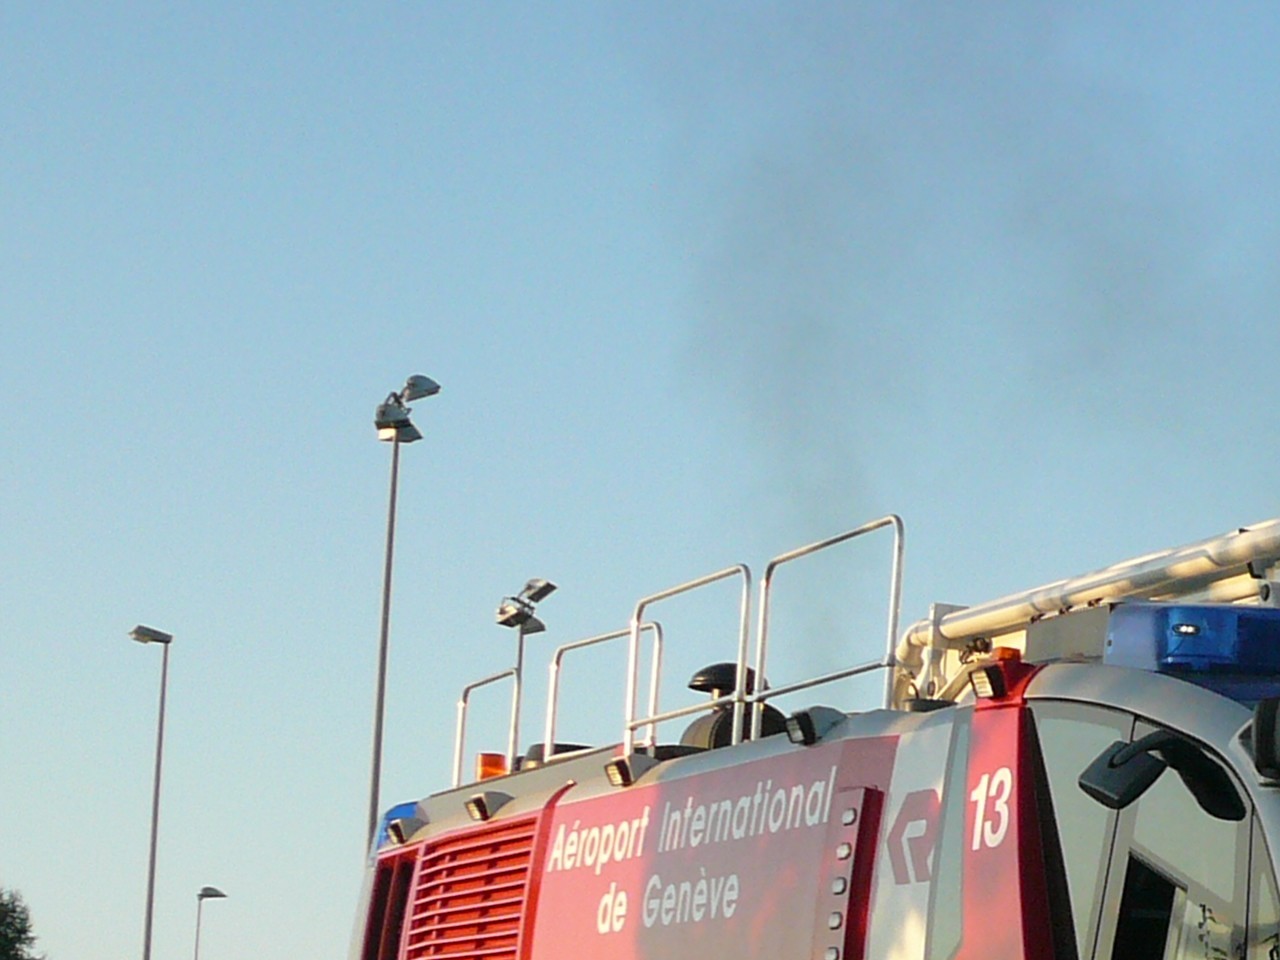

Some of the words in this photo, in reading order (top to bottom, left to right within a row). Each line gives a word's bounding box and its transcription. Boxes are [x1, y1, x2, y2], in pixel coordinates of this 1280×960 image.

[547, 804, 651, 873] Aéroport
[657, 766, 838, 853] International
[969, 766, 1013, 850] 13
[596, 882, 628, 933] de
[641, 868, 740, 928] Genève
